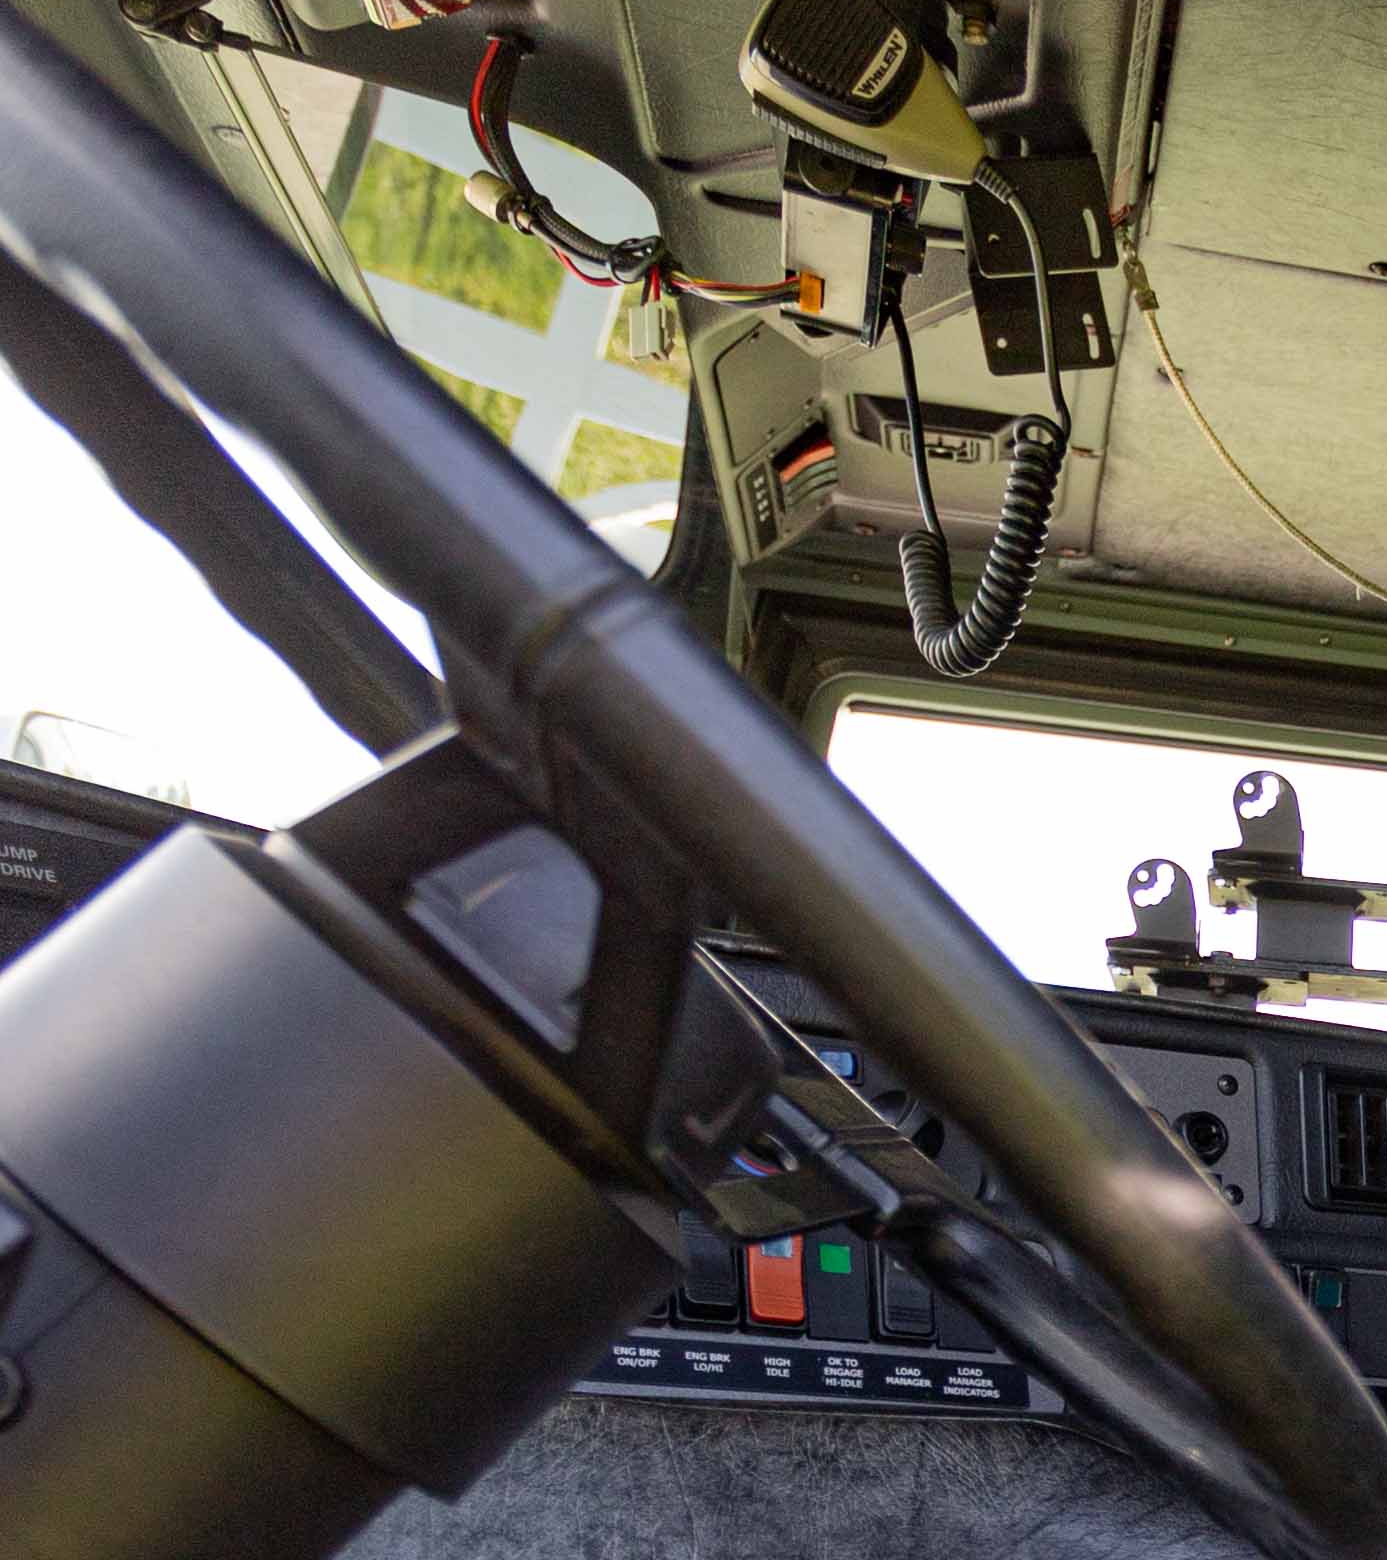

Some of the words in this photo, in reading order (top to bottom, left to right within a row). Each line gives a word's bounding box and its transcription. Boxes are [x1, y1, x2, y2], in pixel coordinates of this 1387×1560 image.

[613, 1346, 636, 1357] ENG
[639, 1347, 661, 1358] BRK
[685, 1351, 707, 1362] ENG
[709, 1353, 731, 1363] BRK
[617, 1357, 658, 1368] ON/OFF
[764, 1357, 791, 1367] HIGH
[827, 1357, 842, 1366] OK
[845, 1358, 858, 1367] TO
[693, 1363, 724, 1373] LO/HI
[766, 1367, 790, 1378] IDLE
[824, 1367, 864, 1378] ENGAGE
[895, 1367, 921, 1377] LOAD
[957, 1367, 983, 1377] LOAD
[825, 1378, 863, 1388] HI-IDLE
[885, 1376, 932, 1388] MANAGER
[949, 1376, 994, 1388] MANAGER
[943, 1387, 1000, 1399] INDICATORS
